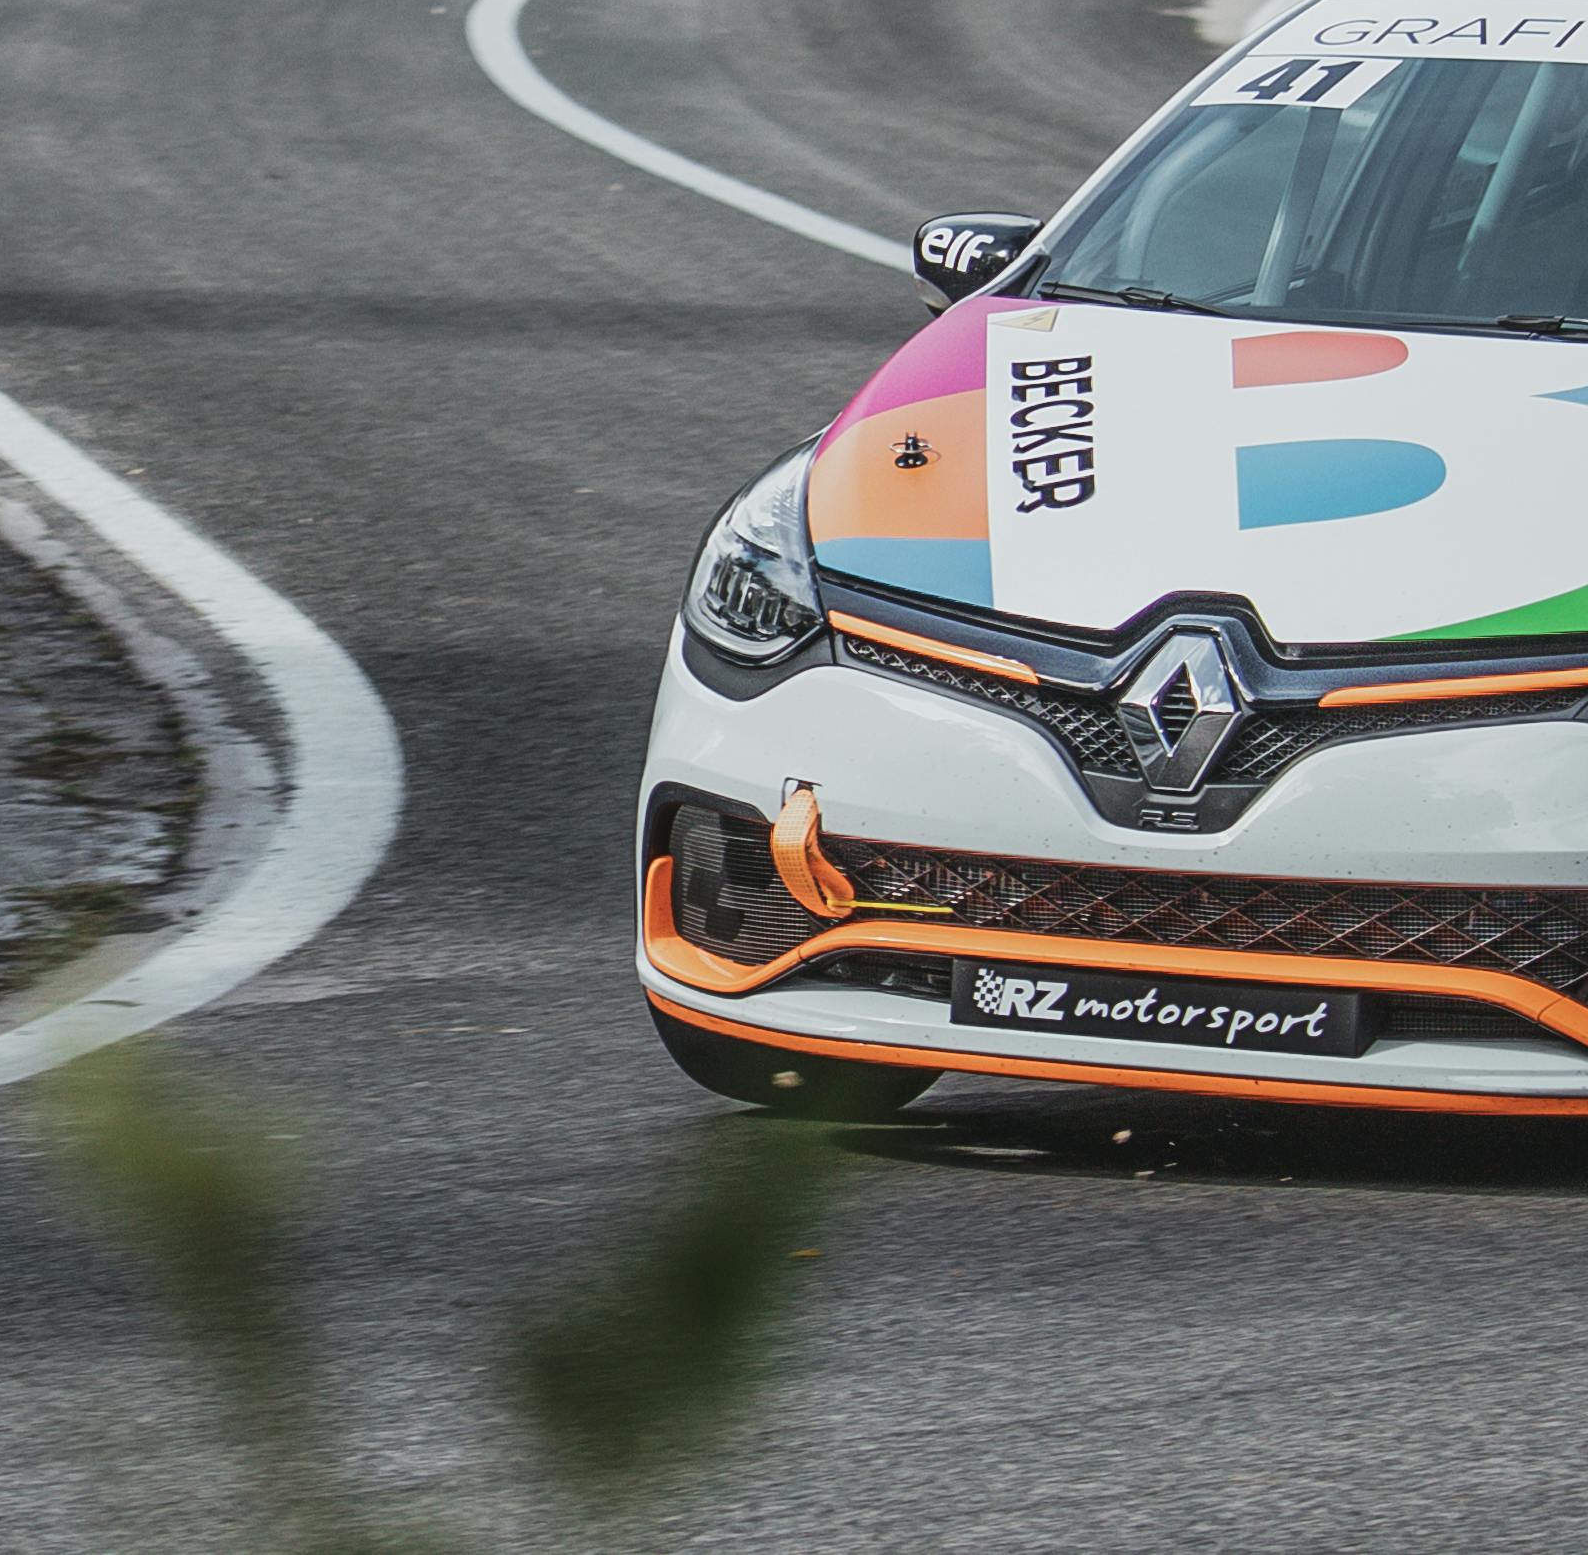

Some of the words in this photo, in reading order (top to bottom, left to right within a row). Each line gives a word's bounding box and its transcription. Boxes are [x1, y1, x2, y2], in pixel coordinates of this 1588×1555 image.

[1236, 59, 1366, 103] 41
[920, 226, 995, 273] elf
[1009, 354, 1097, 515] BECKER
[996, 977, 1069, 1021] RZ
[1074, 987, 1328, 1044] motorsport
